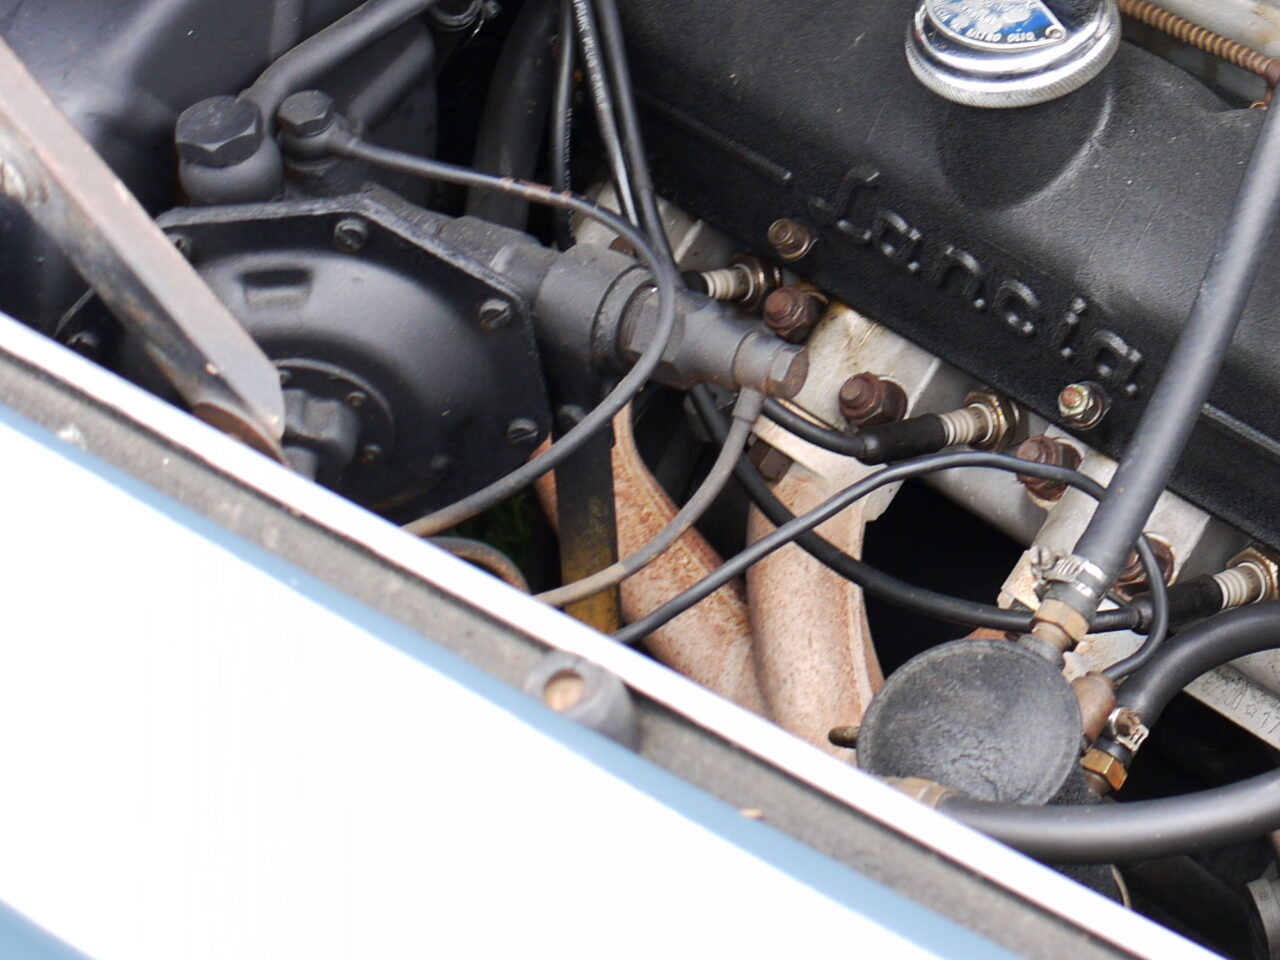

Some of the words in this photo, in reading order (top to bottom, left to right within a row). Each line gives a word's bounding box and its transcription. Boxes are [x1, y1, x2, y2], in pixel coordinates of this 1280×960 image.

[582, 36, 598, 68] PLUG
[591, 73, 609, 111] CABLE
[808, 163, 1143, 396] Lancia
